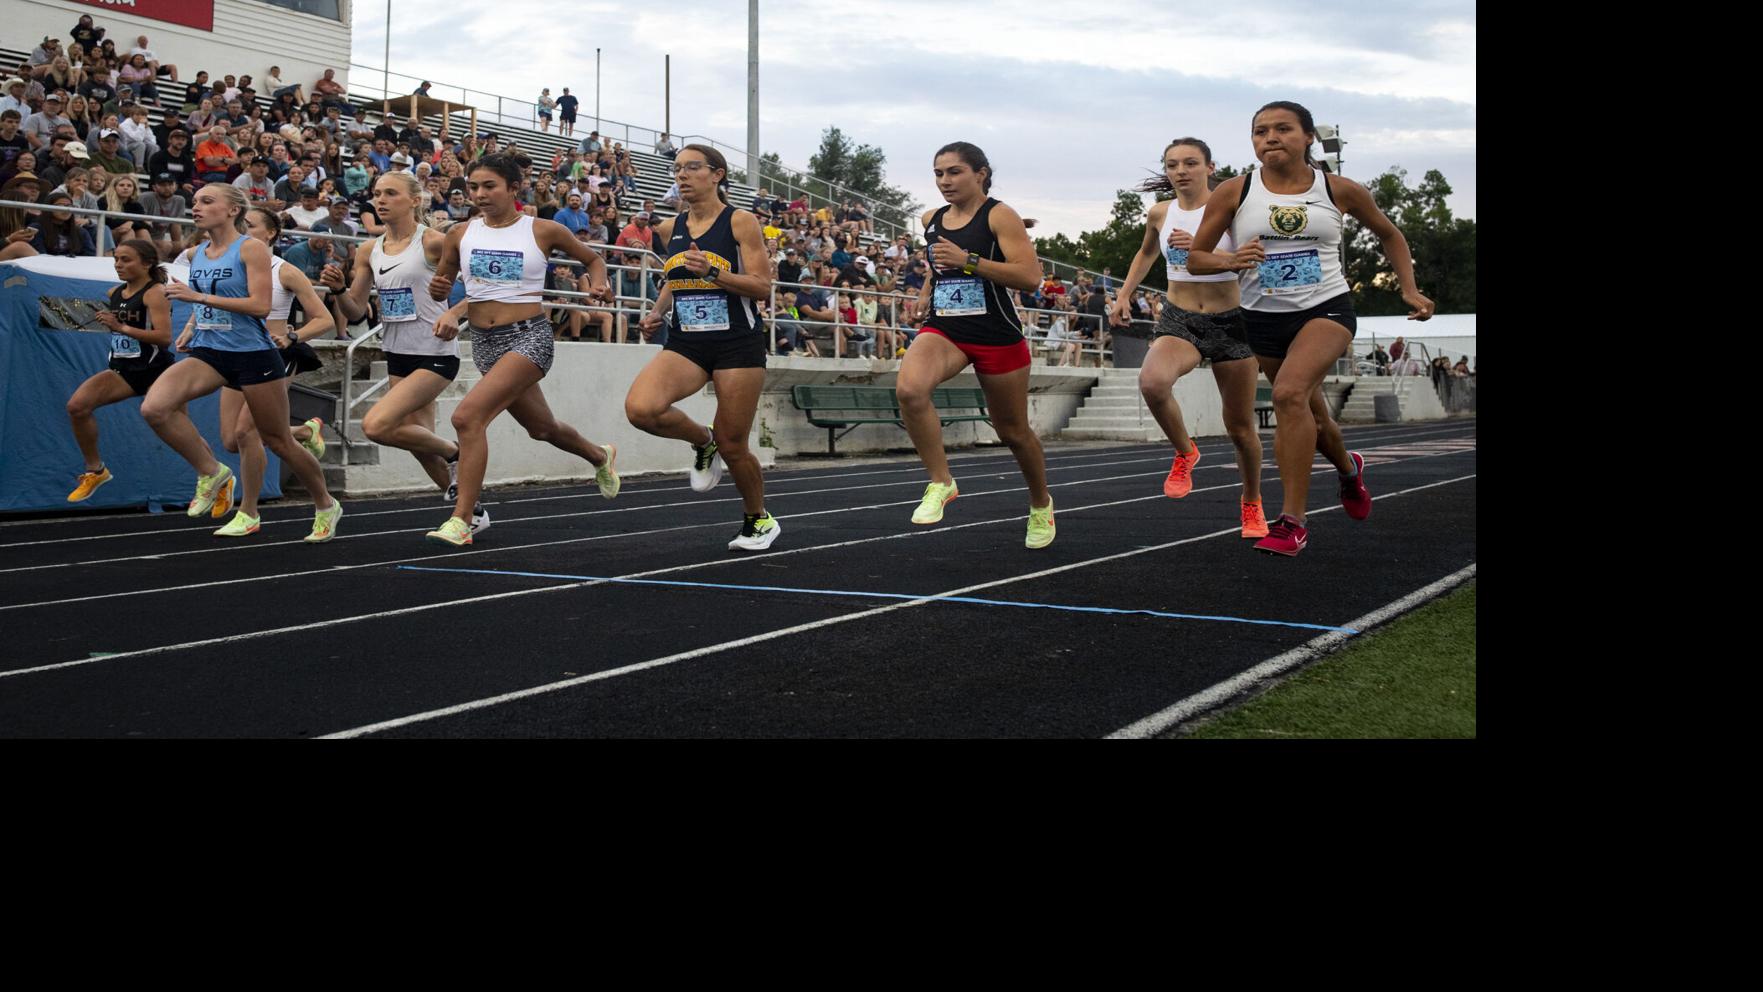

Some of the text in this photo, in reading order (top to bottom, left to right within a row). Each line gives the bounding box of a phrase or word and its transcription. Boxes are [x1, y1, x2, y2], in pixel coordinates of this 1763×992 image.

[488, 260, 502, 275] 6
[1280, 264, 1298, 281] 2
[950, 288, 963, 304] 4
[386, 298, 395, 312] 7
[695, 305, 708, 320] 5
[203, 306, 213, 320] 8
[115, 338, 131, 350] 10
